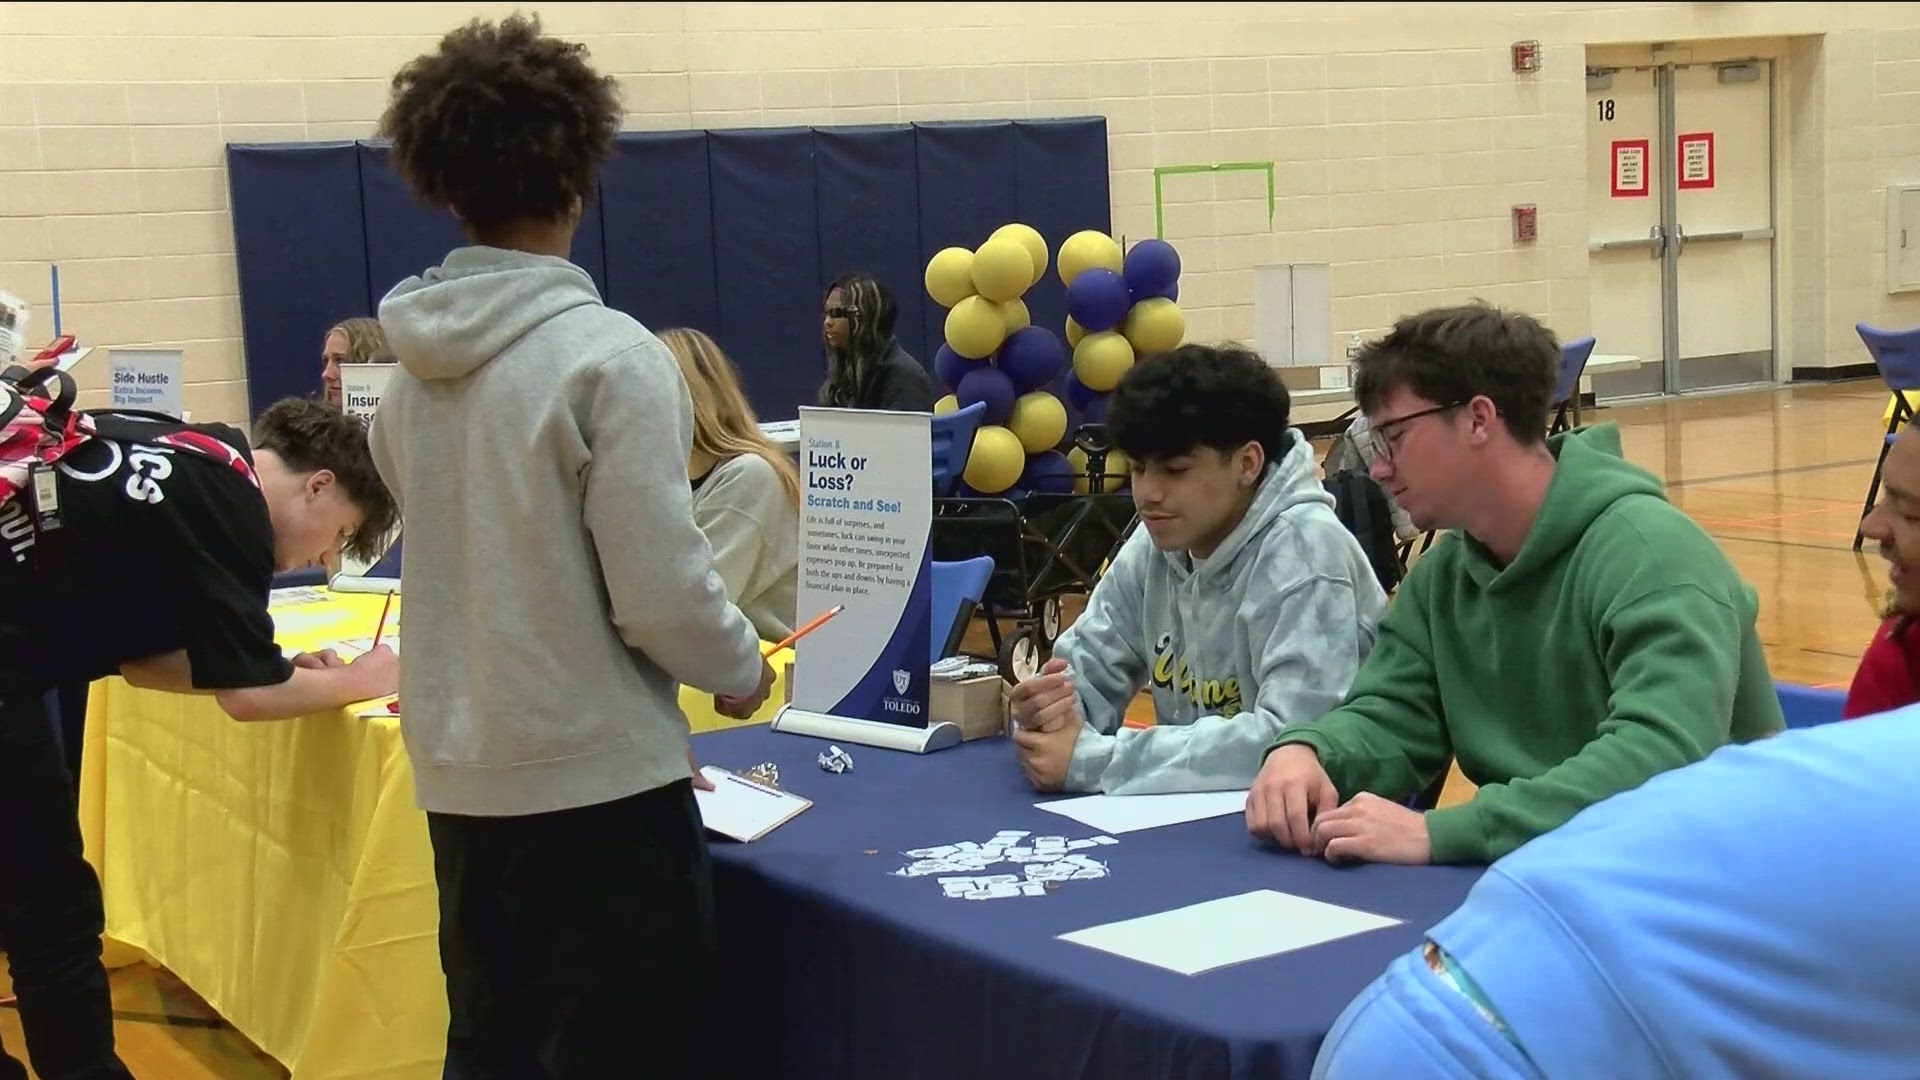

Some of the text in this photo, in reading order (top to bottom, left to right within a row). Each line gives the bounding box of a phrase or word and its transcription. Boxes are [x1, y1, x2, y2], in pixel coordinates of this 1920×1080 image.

[1597, 99, 1615, 121] 18
[113, 372, 169, 384] Side Hustle
[808, 438, 833, 449] Station
[809, 450, 867, 471] Luck or
[809, 471, 854, 491] Loss?
[807, 494, 901, 513] Scratch and See!
[873, 521, 884, 530] and
[892, 537, 905, 545] your
[875, 549, 910, 559] unexpected
[834, 559, 846, 567] pop
[866, 561, 893, 571] prepared
[806, 567, 819, 576] both
[831, 571, 842, 580] ups
[856, 572, 875, 582] downs
[876, 575, 884, 585] by
[885, 576, 905, 587] having
[831, 583, 844, 592] plan
[883, 699, 920, 714] TOLEDO
